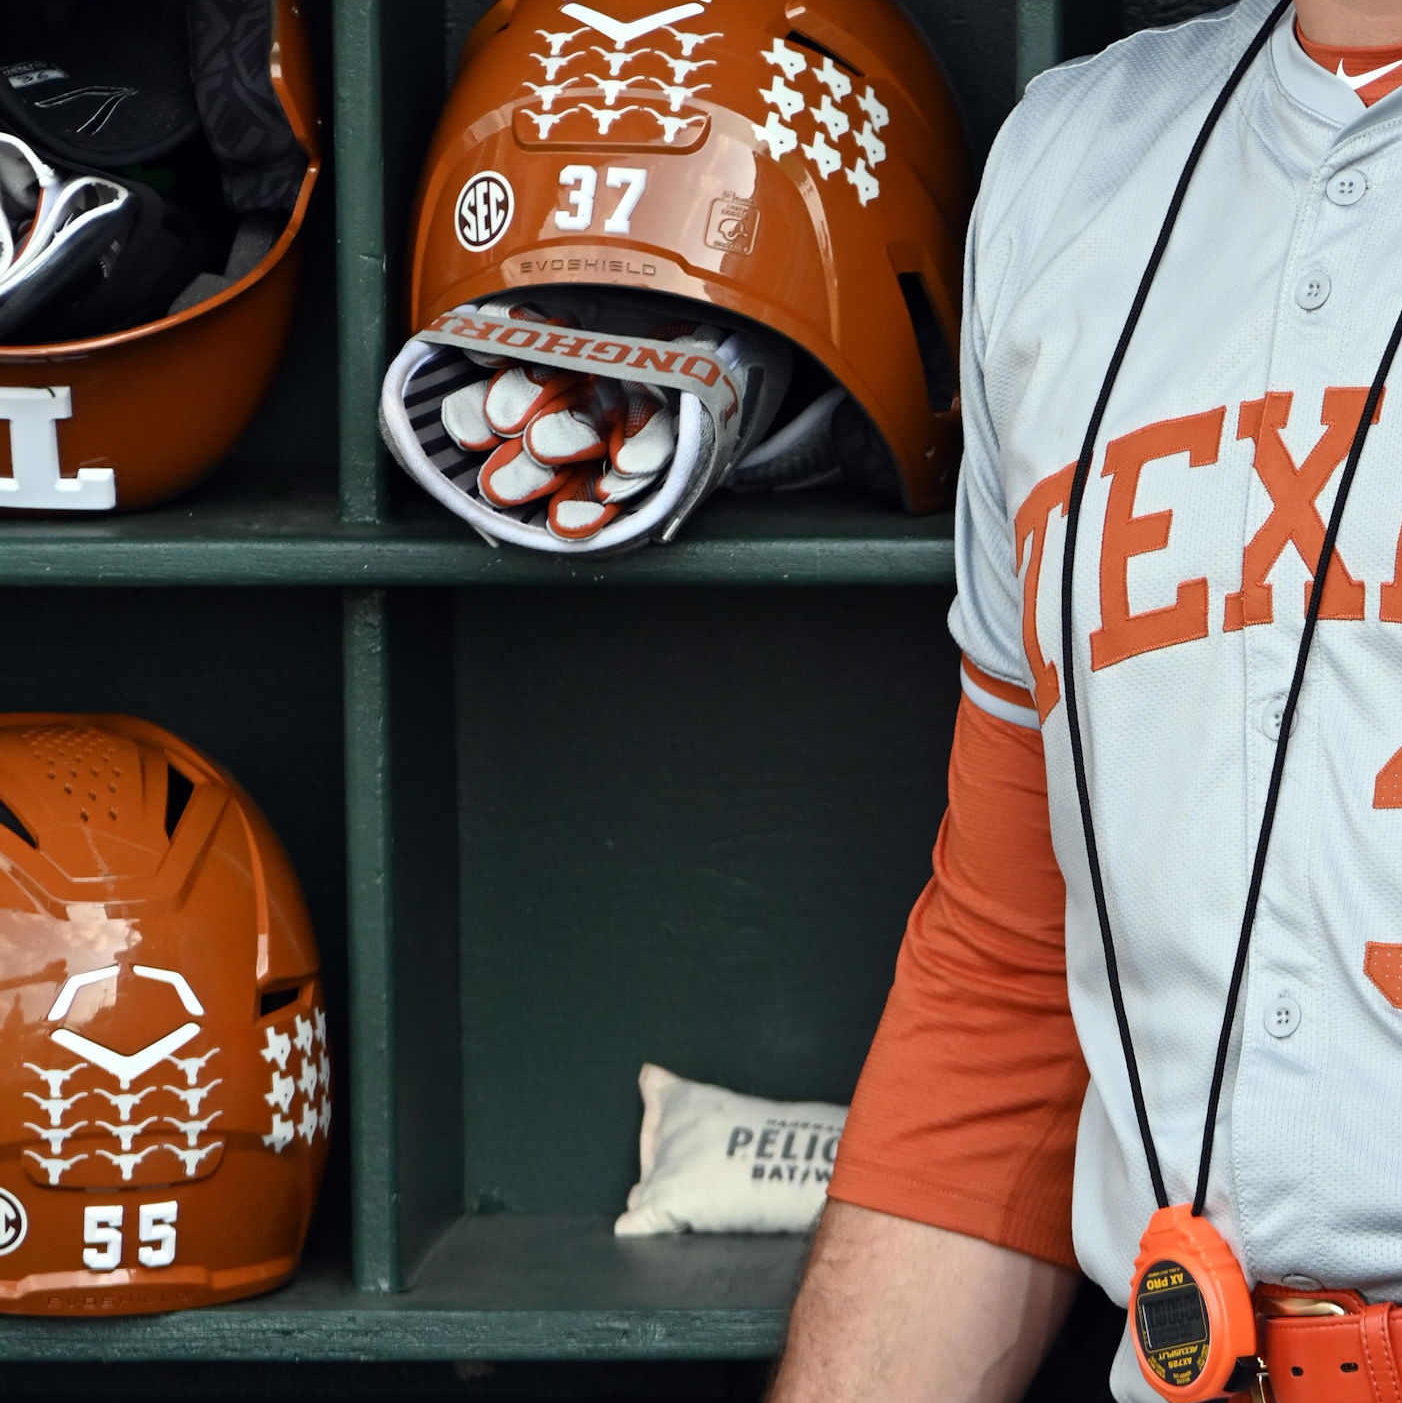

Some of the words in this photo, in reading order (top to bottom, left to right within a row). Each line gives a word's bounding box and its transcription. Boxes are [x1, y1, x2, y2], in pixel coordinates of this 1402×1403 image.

[554, 164, 648, 235] 37
[460, 180, 506, 243] SEC
[519, 258, 658, 278] EVOSHIELD
[82, 1200, 179, 1272] 55
[1146, 1276, 1169, 1291] PRO
[1169, 1272, 1184, 1285] AX
[1157, 1344, 1199, 1361] ACCUSPLIT
